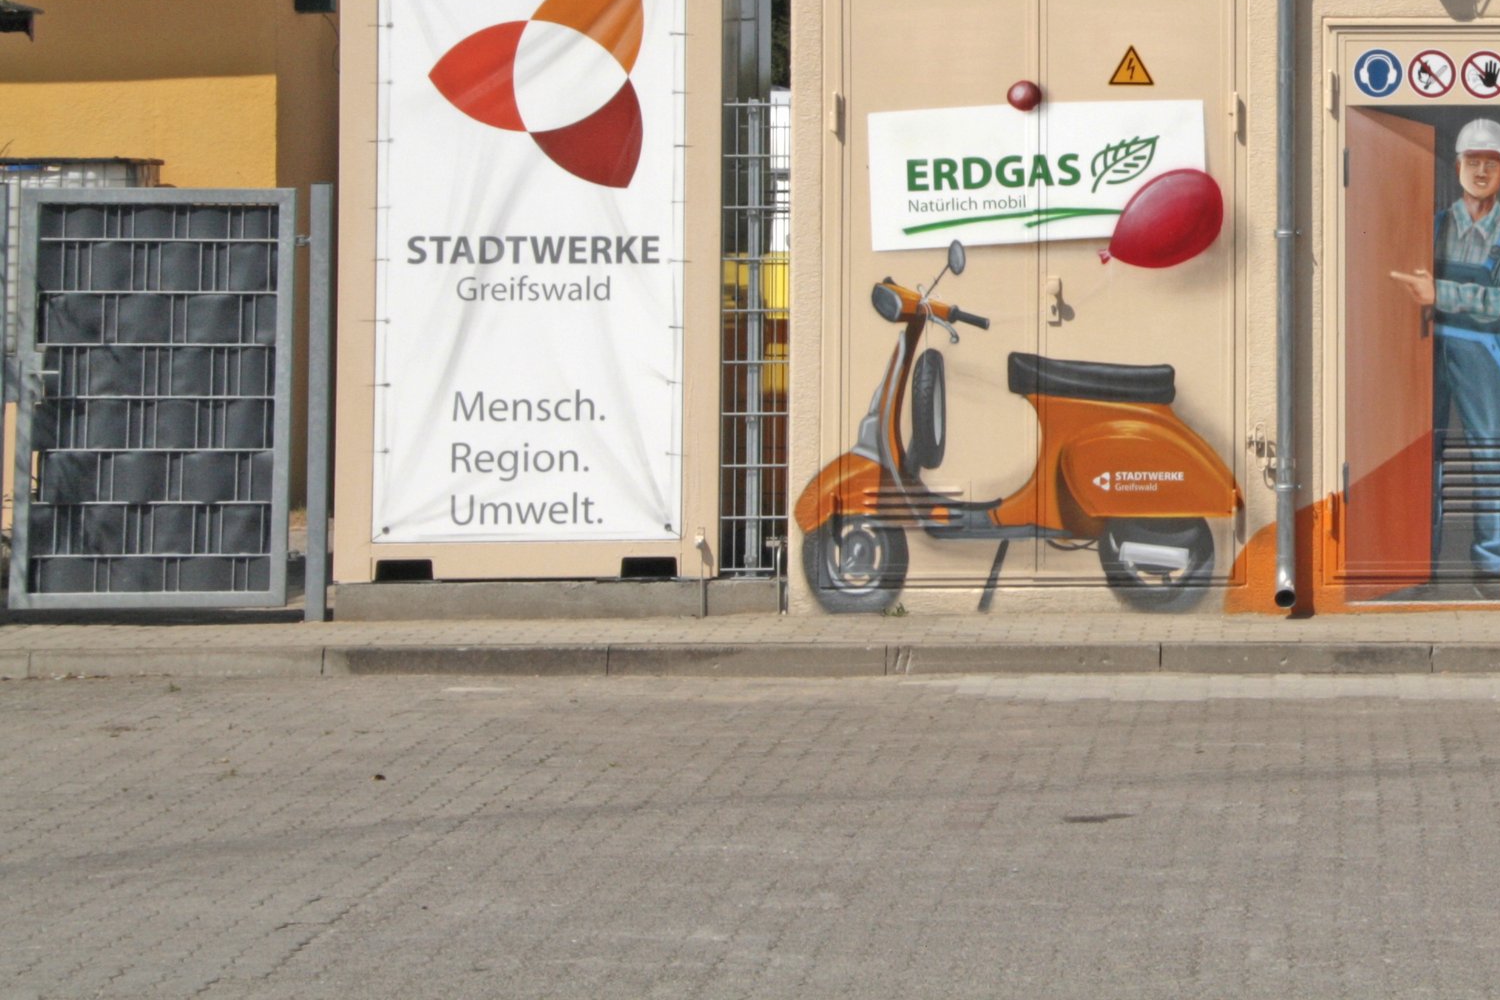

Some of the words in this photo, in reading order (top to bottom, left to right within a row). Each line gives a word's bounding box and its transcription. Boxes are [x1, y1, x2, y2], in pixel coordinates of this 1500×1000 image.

[906, 153, 1081, 192] ERDGAS
[908, 197, 978, 213] Natürlich
[983, 195, 1027, 210] mobil
[407, 235, 660, 264] STADTWERKE
[456, 275, 611, 301] Greifswald
[452, 388, 605, 422] Mensch.
[451, 442, 589, 482] Region.
[1115, 471, 1185, 481] STADTWERKE
[1115, 483, 1158, 492] Greifswald
[450, 491, 603, 525] Umwelt.
